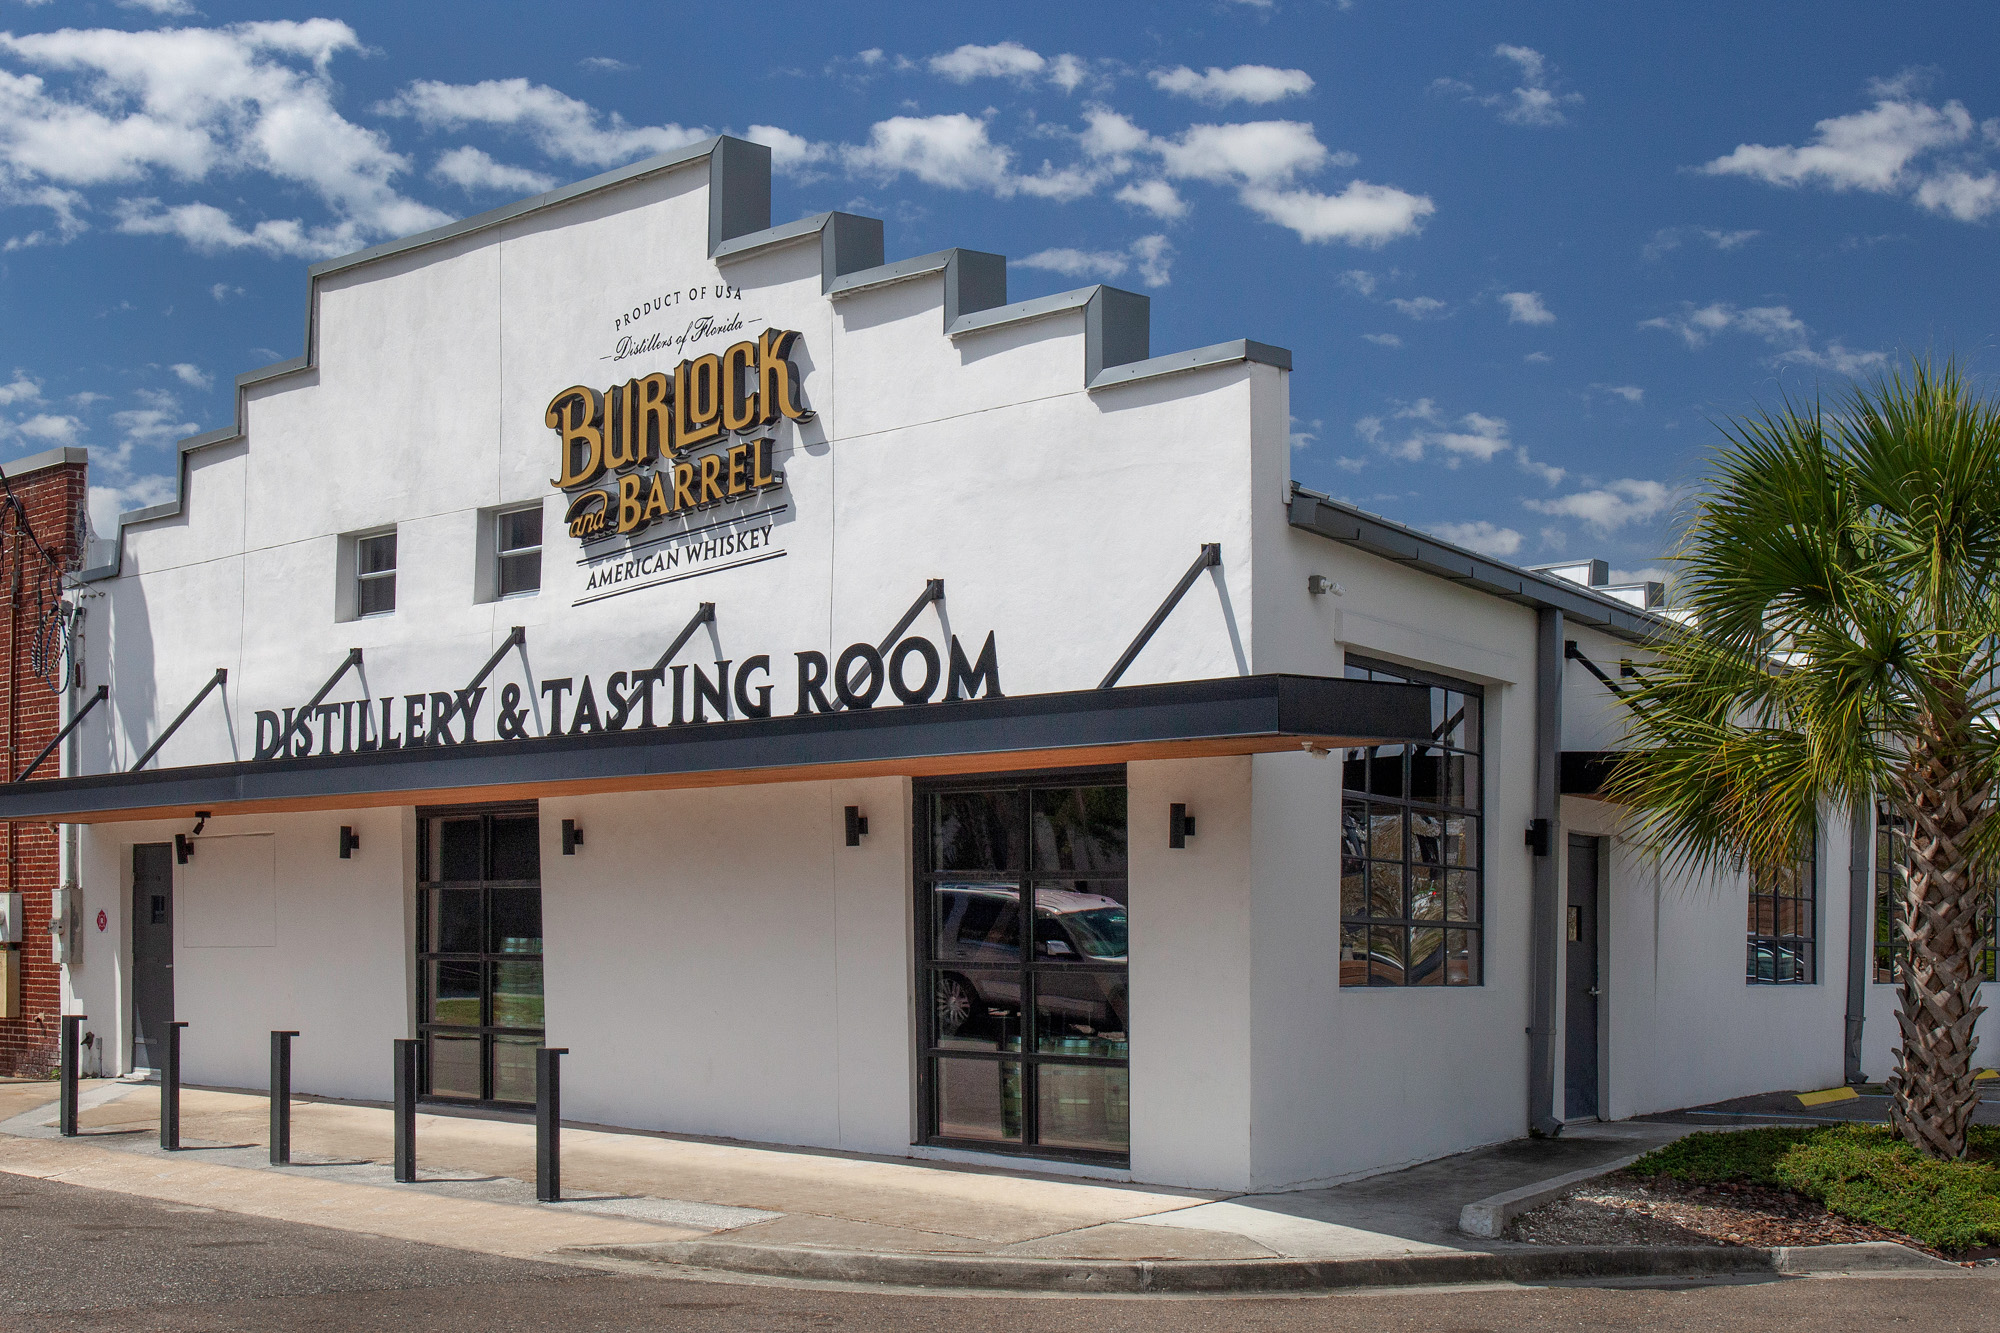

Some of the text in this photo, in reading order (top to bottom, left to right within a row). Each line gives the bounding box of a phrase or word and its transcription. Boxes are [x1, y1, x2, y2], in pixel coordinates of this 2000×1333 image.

[613, 312, 743, 361] Distillers of Florida
[615, 285, 743, 331] PRODUCT OF USA
[545, 327, 804, 489] BURLOCK
[565, 438, 776, 538] and BARREL
[586, 525, 773, 590] AMERICAN WHISKEY
[256, 629, 1004, 761] DISTILLERY & TASTING ROOM
